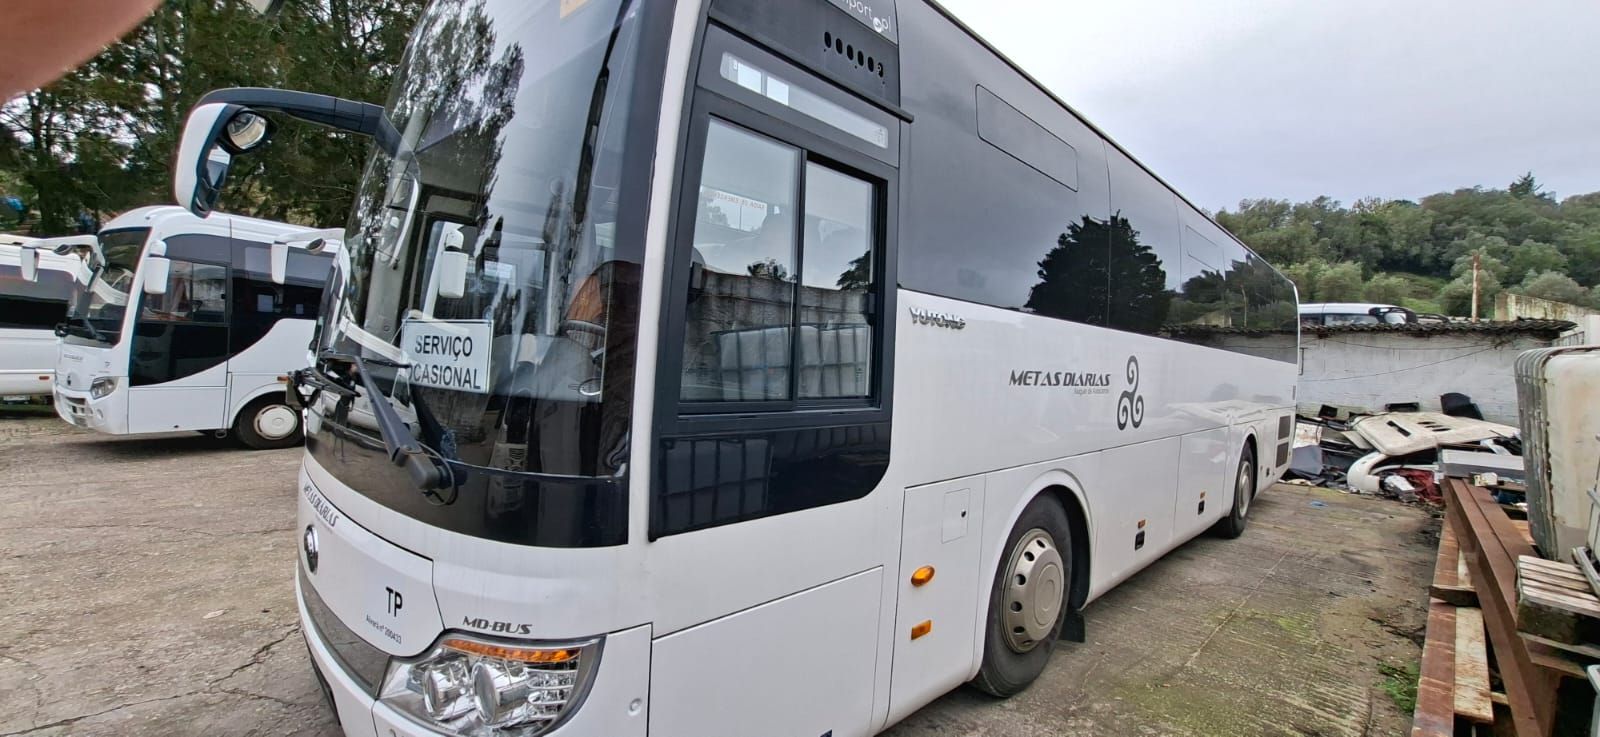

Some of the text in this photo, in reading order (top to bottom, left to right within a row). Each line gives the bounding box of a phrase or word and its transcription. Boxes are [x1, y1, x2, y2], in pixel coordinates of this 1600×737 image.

[415, 335, 473, 361] SERVIÇO
[1009, 369, 1062, 387] METAS
[385, 586, 403, 617] TP
